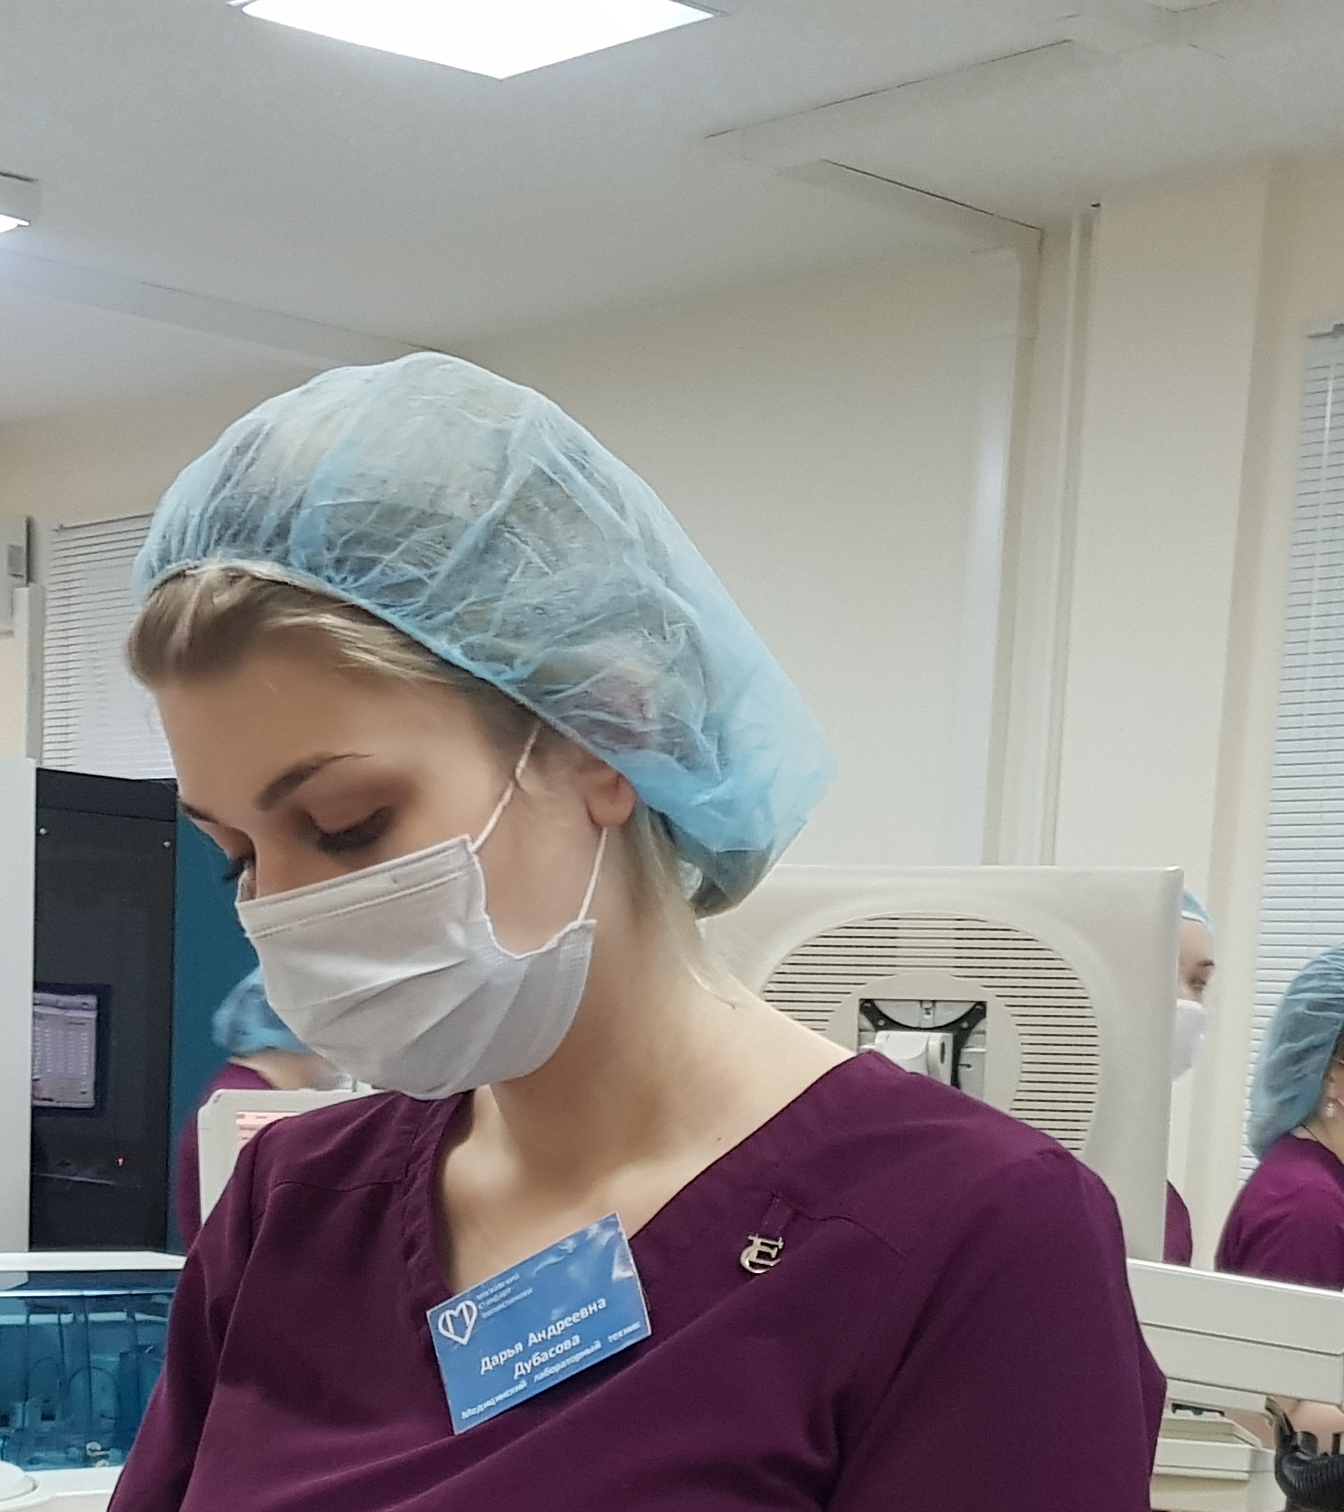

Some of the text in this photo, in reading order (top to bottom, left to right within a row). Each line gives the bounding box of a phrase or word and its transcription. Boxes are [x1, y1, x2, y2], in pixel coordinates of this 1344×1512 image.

[461, 1320, 641, 1420] Медицинский лабораторный техник
[479, 1297, 606, 1375] Дарья Андреевна
[513, 1333, 581, 1379] Дубасова
